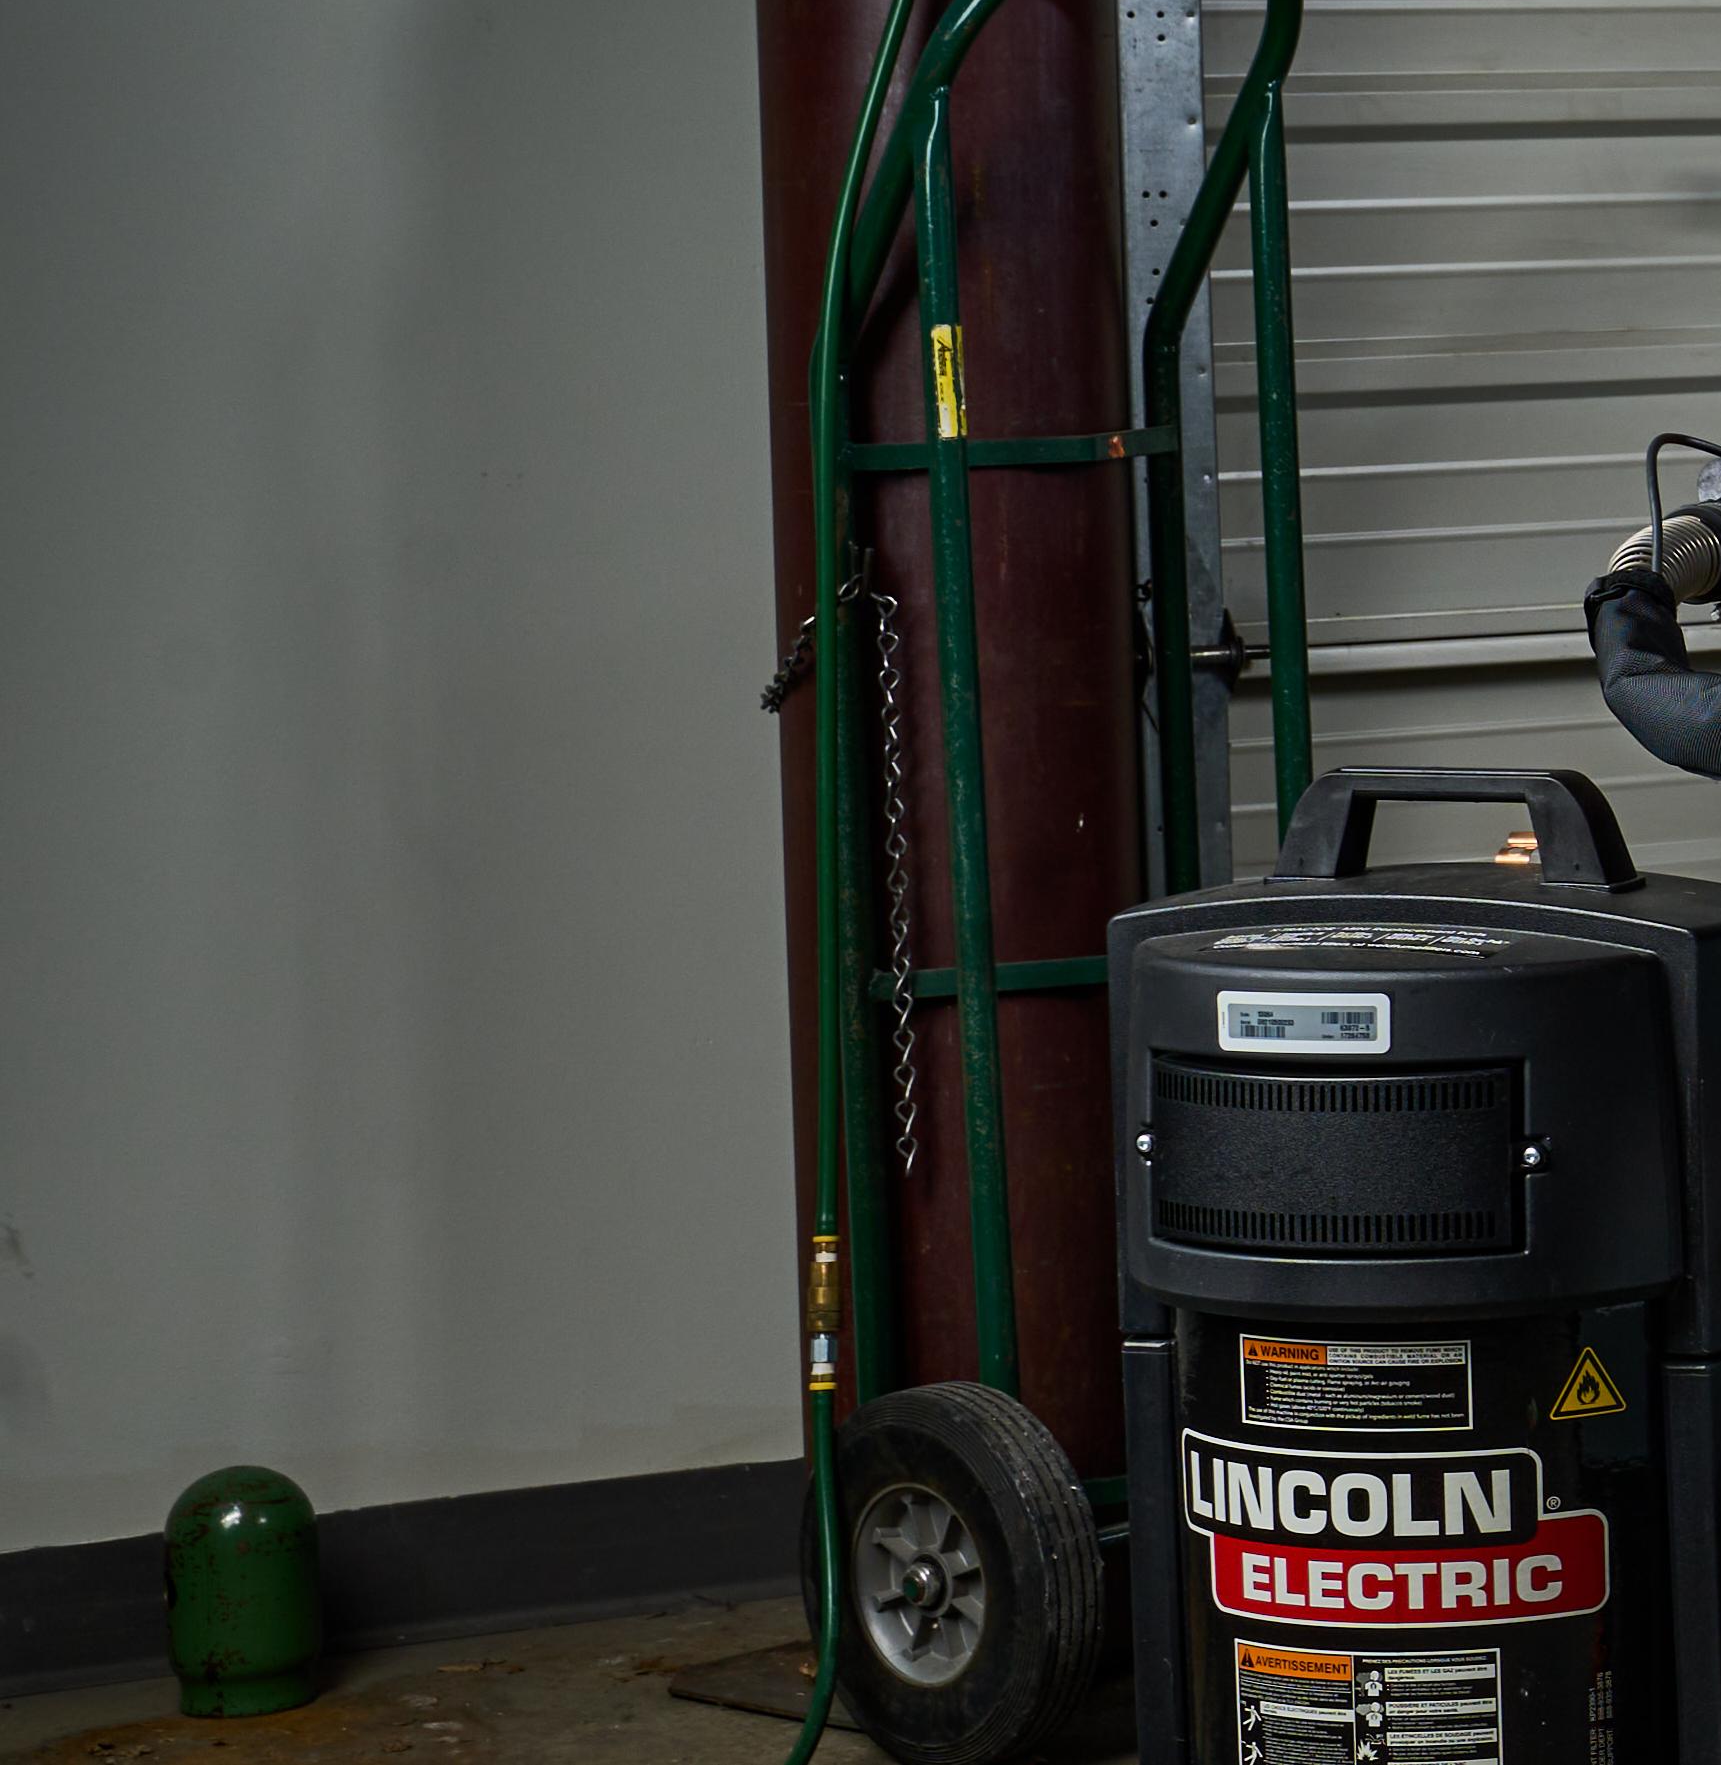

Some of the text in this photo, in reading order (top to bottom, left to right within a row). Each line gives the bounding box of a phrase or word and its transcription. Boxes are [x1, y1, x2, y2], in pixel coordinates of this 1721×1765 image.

[1260, 1344, 1320, 1361] WARNING
[1191, 1449, 1512, 1538] LINCOLN
[1241, 1553, 1565, 1610] ELECTRIC
[1255, 1655, 1350, 1675] AVERTISSEMENT
